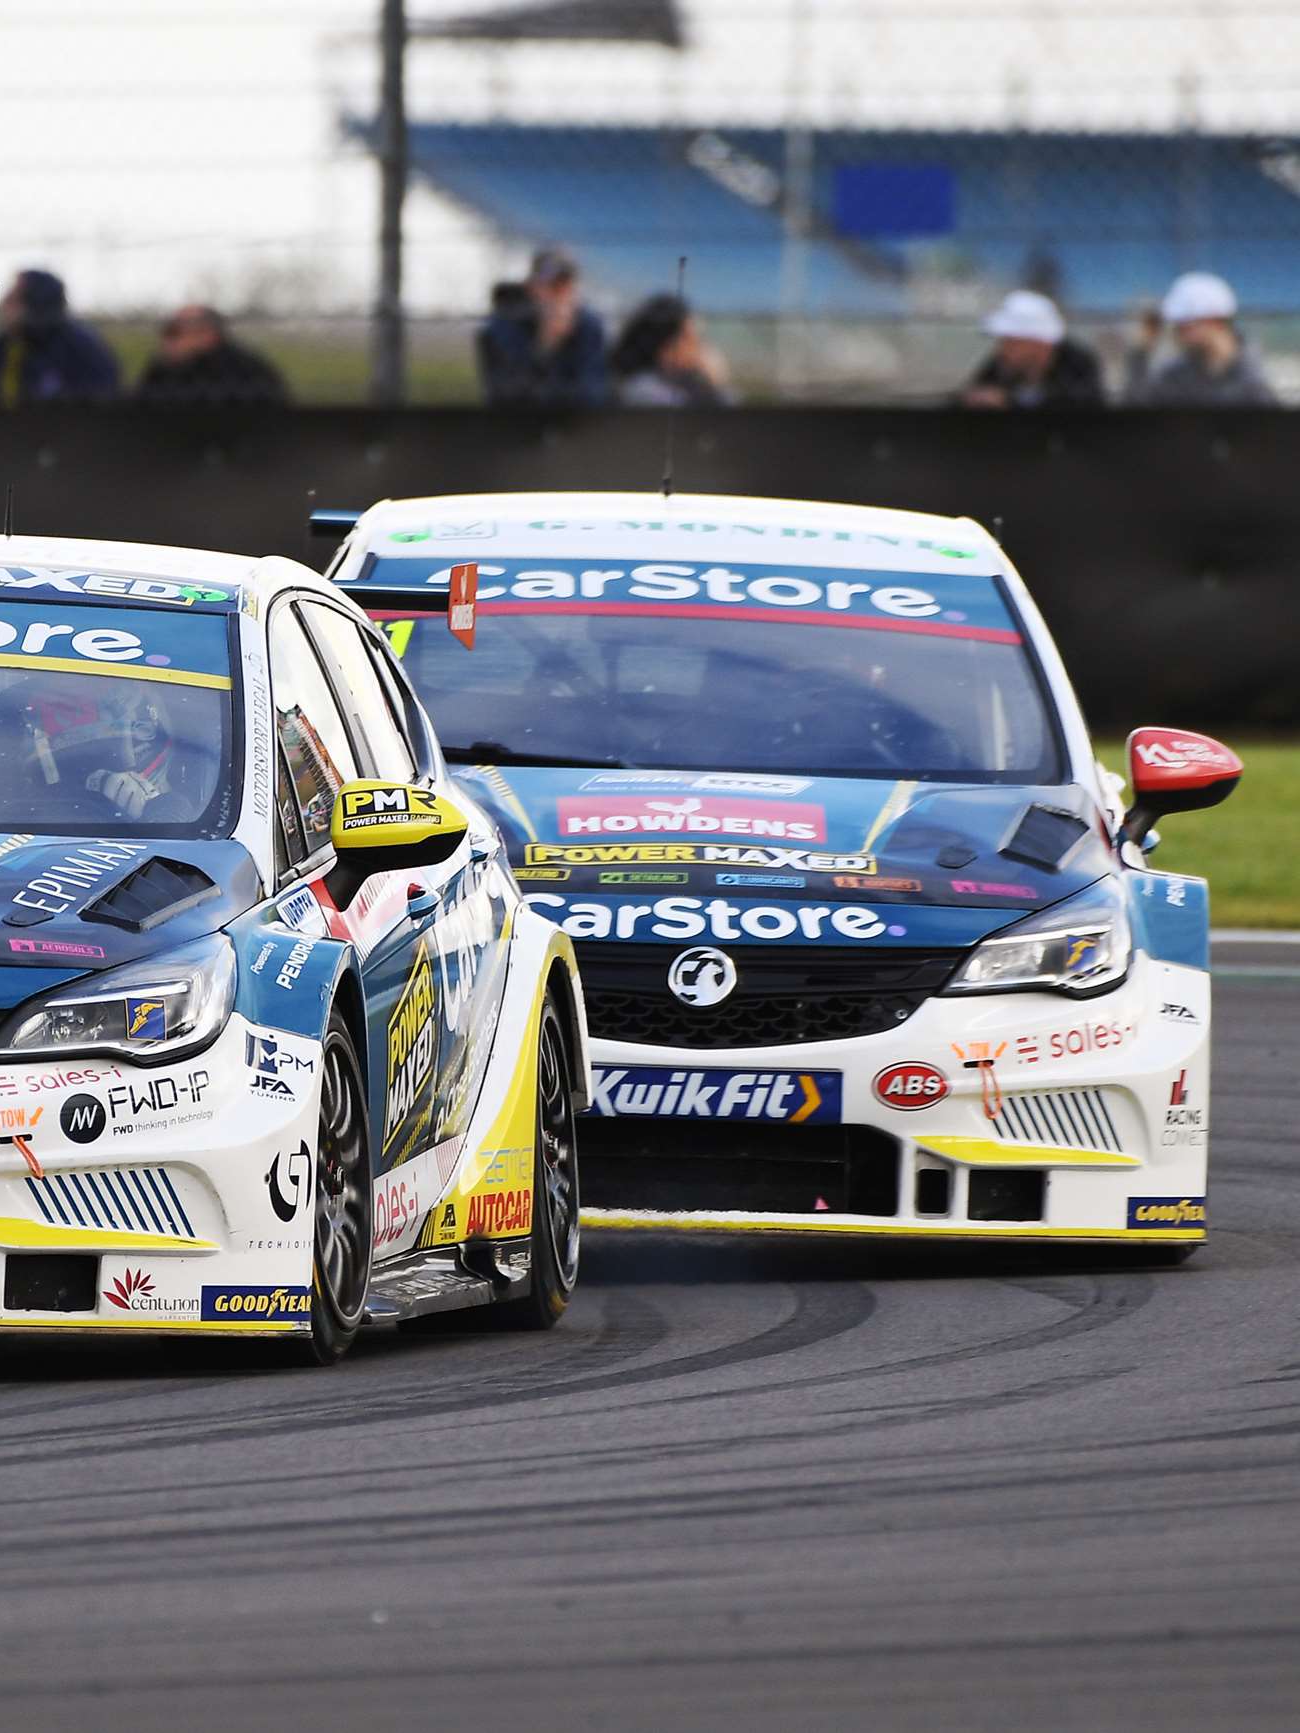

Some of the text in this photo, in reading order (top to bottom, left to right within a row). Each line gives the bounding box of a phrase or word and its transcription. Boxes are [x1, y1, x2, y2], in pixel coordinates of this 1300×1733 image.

[376, 620, 415, 660] 1
[345, 788, 438, 815] PMR
[344, 815, 378, 829] POWER
[379, 813, 409, 825] MAXED
[567, 815, 818, 840] HOWDENS
[534, 845, 869, 871] POWER MAXED
[12, 840, 148, 914] EPIMAX
[390, 962, 434, 1067] POWER
[259, 1045, 315, 1074] MPM
[28, 1065, 123, 1093] sales-i
[248, 1074, 296, 1095] JFA
[386, 1016, 433, 1139] MAXED
[885, 1075, 943, 1096] ABS
[108, 1070, 210, 1118] FWD-IP
[0, 1109, 27, 1129] TOW
[113, 1124, 134, 1136] FWD
[135, 1118, 168, 1133] thinking
[177, 1110, 214, 1124] technology
[466, 1189, 531, 1236] AUTOCAR
[131, 1295, 200, 1312] centurion
